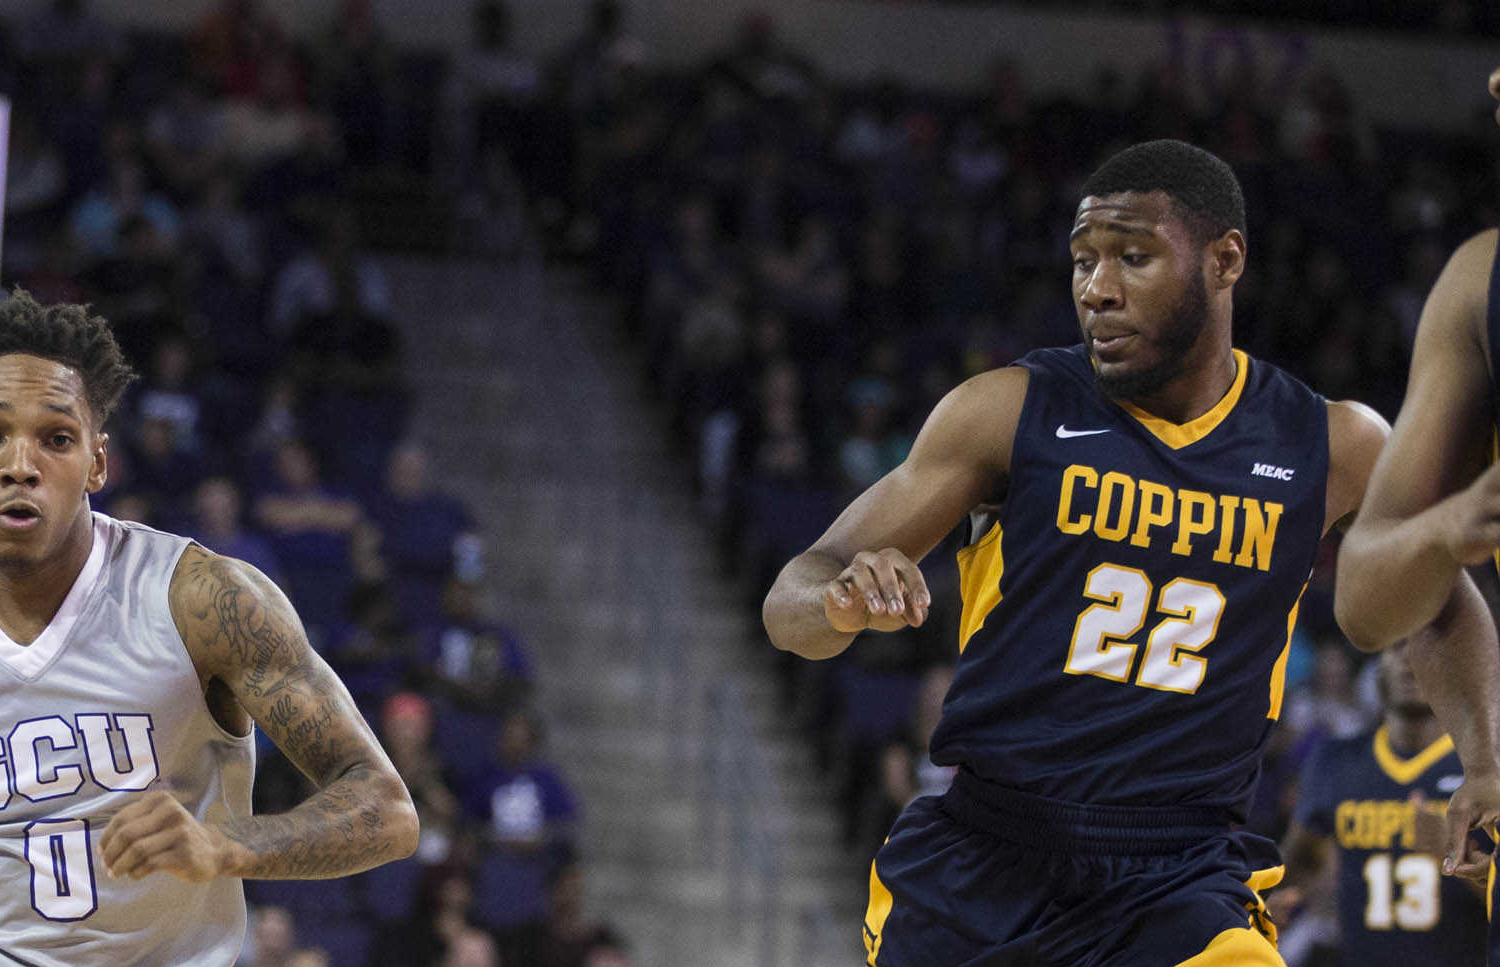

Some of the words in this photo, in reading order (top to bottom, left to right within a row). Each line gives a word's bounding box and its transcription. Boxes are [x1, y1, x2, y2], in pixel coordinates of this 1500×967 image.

[1056, 464, 1284, 572] COPPIN
[1251, 462, 1295, 481] MEAC
[1063, 562, 1227, 695] 22
[23, 818, 98, 922] 0
[1364, 852, 1440, 931] 13
